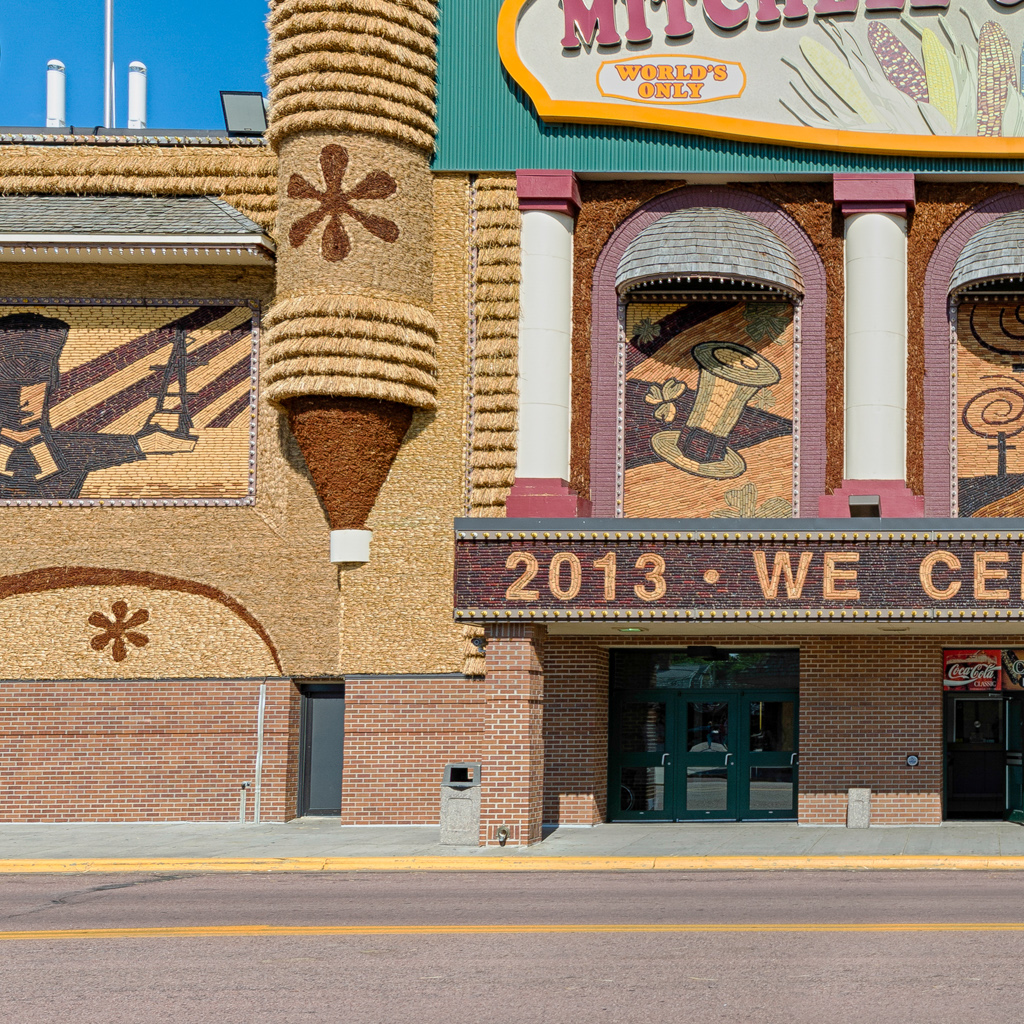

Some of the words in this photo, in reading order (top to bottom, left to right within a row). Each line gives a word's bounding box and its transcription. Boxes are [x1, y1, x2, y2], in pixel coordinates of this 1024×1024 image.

[614, 64, 728, 81] WORLD'S
[638, 82, 704, 99] ONLY
[505, 551, 667, 601] 2013
[752, 551, 860, 600] WE
[948, 663, 996, 679] Coca-Cola
[973, 680, 997, 688] CLASSIC
